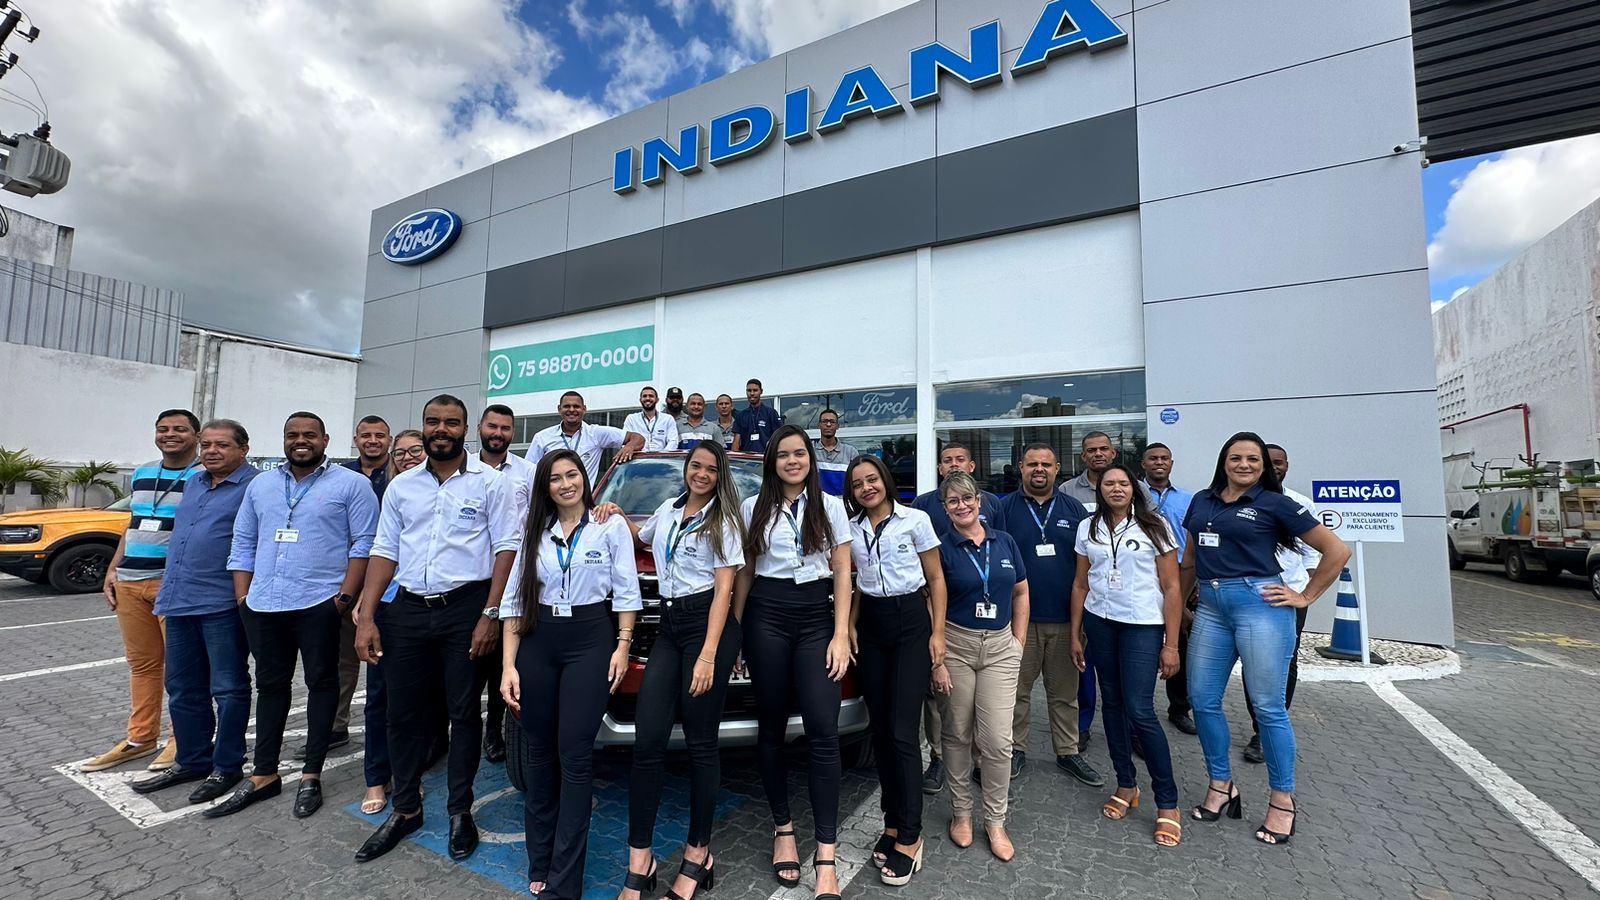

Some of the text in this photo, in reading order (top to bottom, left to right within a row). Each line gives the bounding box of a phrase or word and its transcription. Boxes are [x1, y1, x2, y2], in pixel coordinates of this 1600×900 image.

[613, 0, 1128, 194] INDIANA
[388, 214, 441, 257] Ford
[517, 343, 654, 378] 75 98870-0000
[857, 391, 910, 417] Ford
[1317, 483, 1396, 501] ATENÇÃO
[1322, 513, 1334, 528] E
